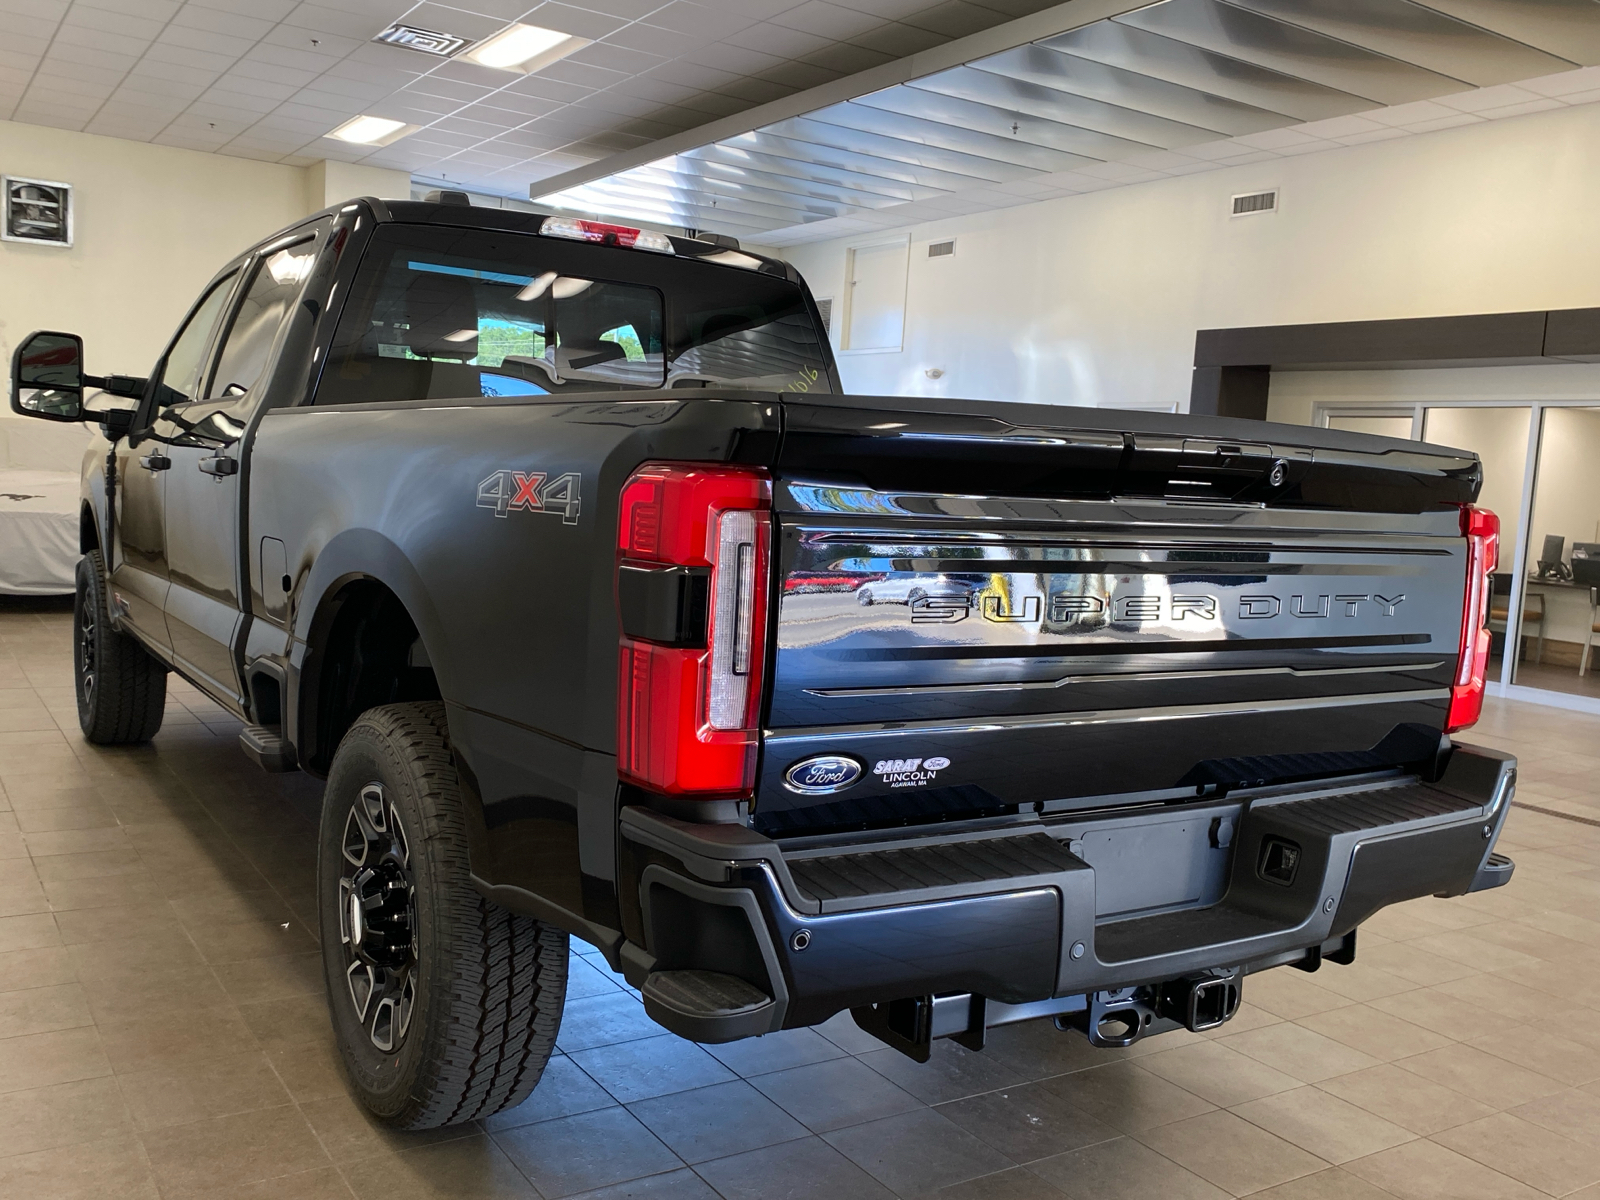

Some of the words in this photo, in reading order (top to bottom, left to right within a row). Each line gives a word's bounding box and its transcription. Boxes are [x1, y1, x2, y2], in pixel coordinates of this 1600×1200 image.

[910, 594, 1216, 624] SUPER
[1238, 594, 1405, 620] DUTY
[805, 763, 847, 784] Ford
[873, 758, 923, 775] SARAT
[882, 770, 937, 783] LINCOLN
[890, 780, 917, 788] AGAWAM,
